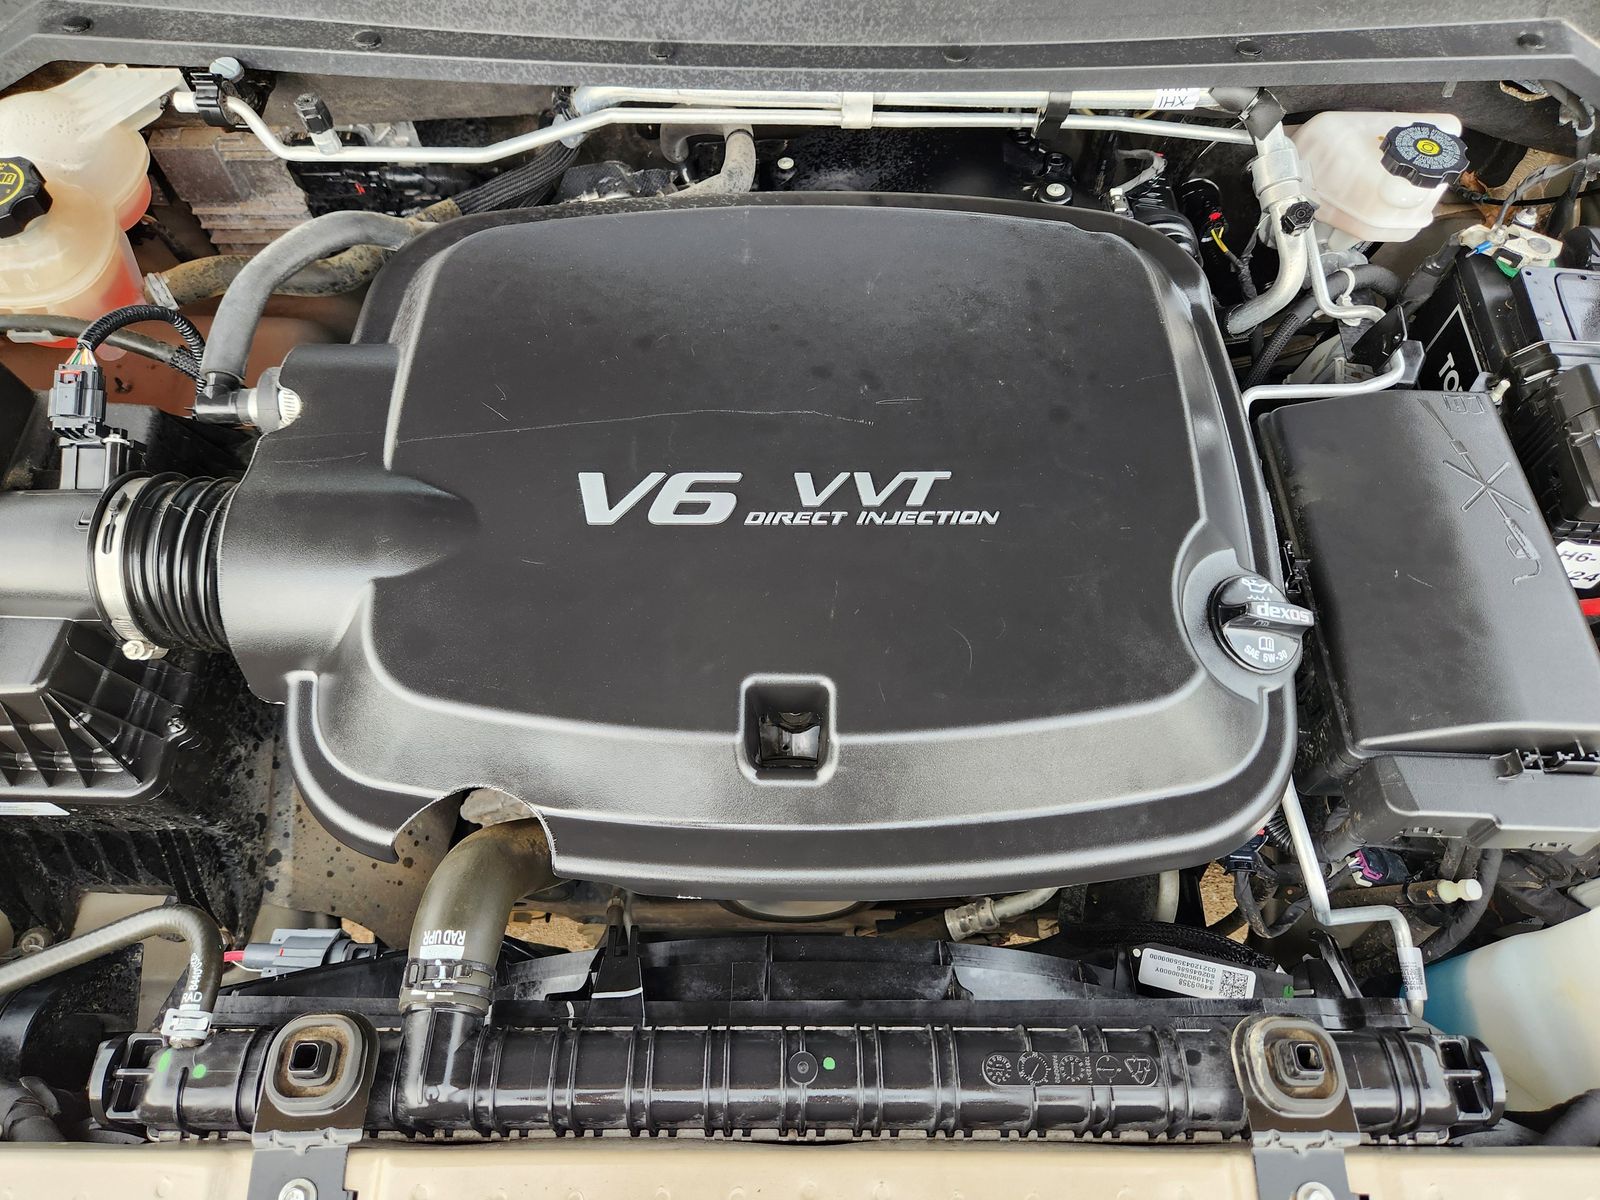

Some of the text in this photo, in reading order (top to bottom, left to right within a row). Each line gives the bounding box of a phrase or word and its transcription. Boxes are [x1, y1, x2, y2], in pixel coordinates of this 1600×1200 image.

[578, 471, 952, 526] V6 VVT
[743, 509, 1000, 526] DIRECT INJECTION
[1256, 601, 1310, 623] dexos
[1243, 645, 1288, 663] SAE 5W-30
[422, 929, 466, 946] RAD UPR
[181, 991, 203, 1004] RAD
